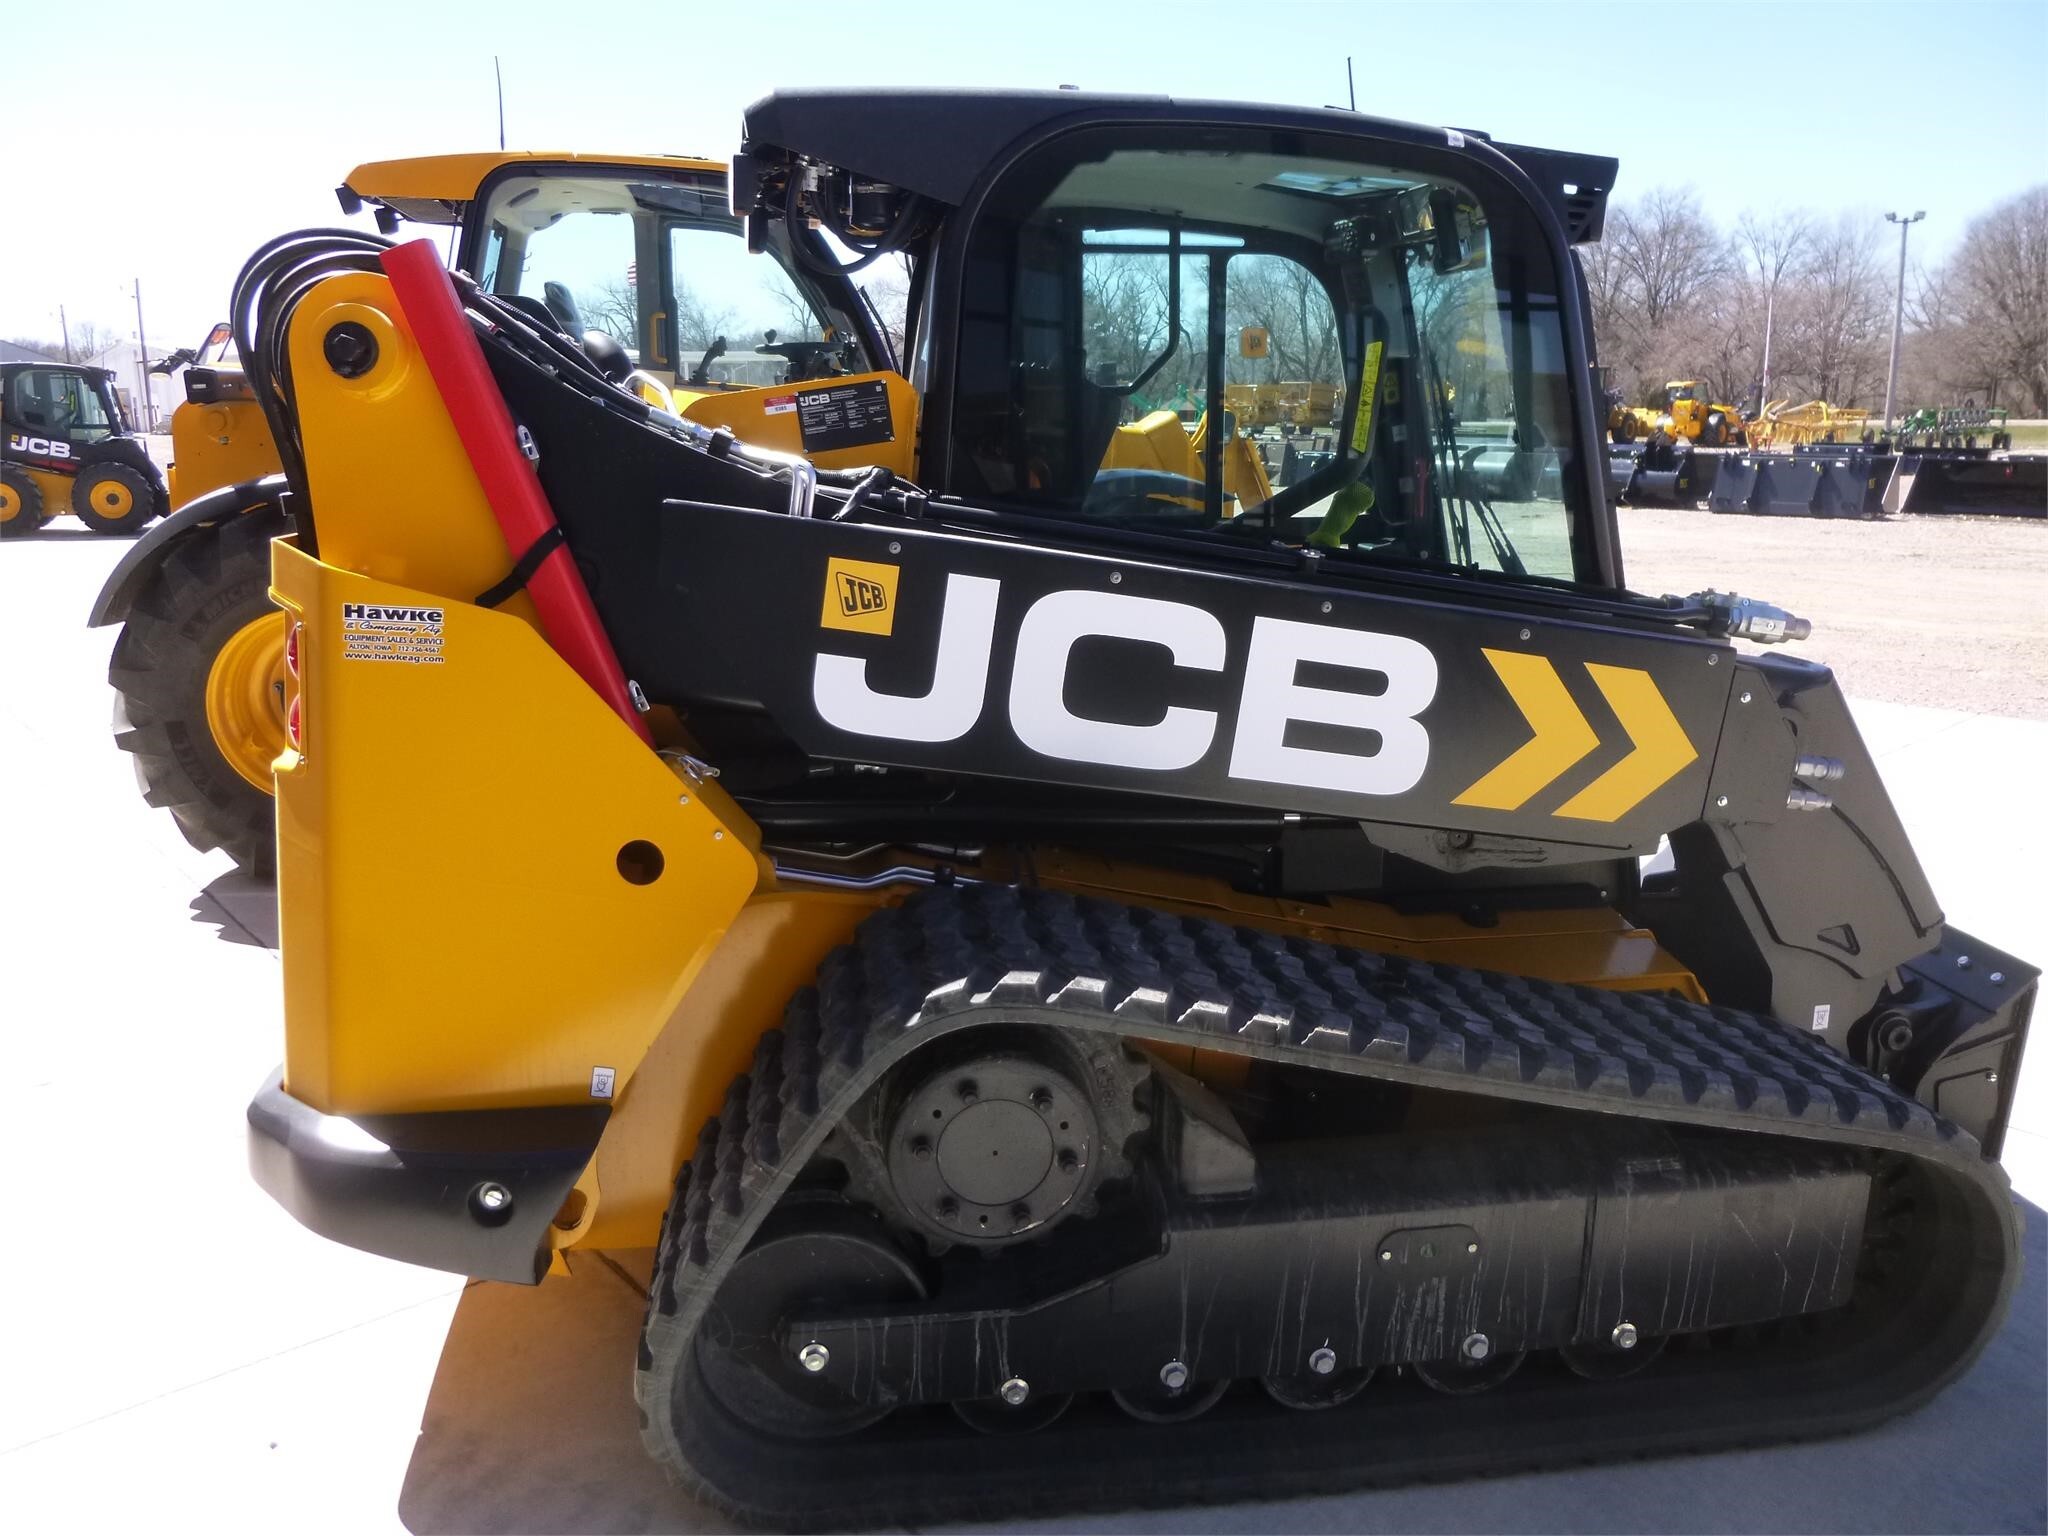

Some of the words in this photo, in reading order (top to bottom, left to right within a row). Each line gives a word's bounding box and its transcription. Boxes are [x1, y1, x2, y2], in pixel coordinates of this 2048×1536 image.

[800, 393, 831, 407] JCB
[10, 435, 71, 459] JCB
[843, 577, 884, 612] JCB
[359, 621, 418, 634] Company
[422, 624, 441, 636] Ag
[344, 634, 385, 643] EQUIPMENT
[387, 635, 407, 645] SALES
[415, 637, 444, 645] SERVICE
[344, 652, 444, 664] www.hawkeag.com
[812, 572, 1439, 796] JCB
